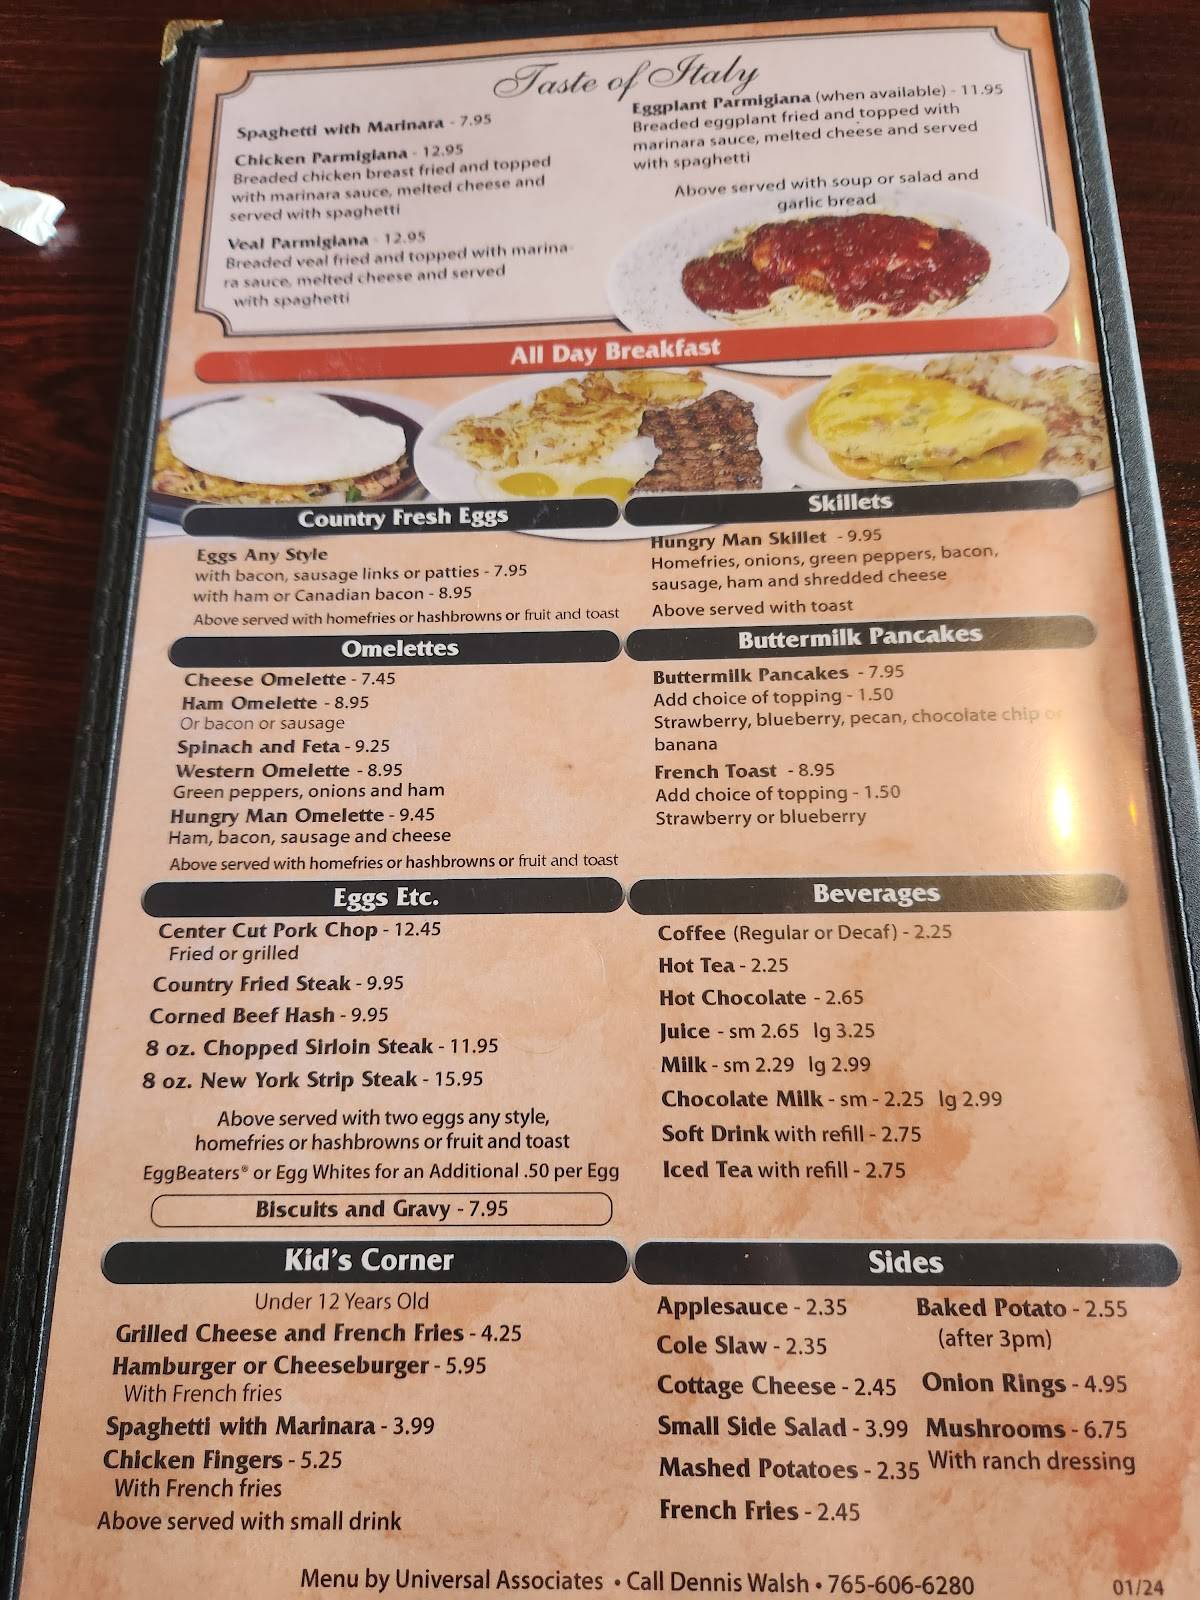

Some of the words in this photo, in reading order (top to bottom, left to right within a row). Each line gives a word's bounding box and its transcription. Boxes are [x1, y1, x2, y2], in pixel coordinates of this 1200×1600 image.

[493, 62, 598, 98] Taste
[608, 60, 651, 101] of
[648, 53, 759, 96] Italy
[632, 99, 706, 116] Eggplant
[713, 93, 811, 109] Parmigiana
[815, 89, 865, 103] (when
[869, 84, 946, 99] available)
[961, 83, 1003, 95] 11.95
[237, 124, 317, 142] Spaghetti
[324, 122, 360, 135] with
[367, 119, 444, 133] Marinara
[460, 113, 492, 126] 7.95
[633, 137, 705, 151] marinara
[764, 127, 821, 143] melted
[826, 126, 883, 139] cheese
[887, 122, 918, 135] and
[923, 120, 978, 134] served
[234, 153, 305, 166] Chicken
[312, 149, 408, 164] Parmigiana
[423, 143, 463, 157] 12.95
[674, 184, 727, 197] Above
[731, 178, 786, 193] served
[790, 175, 827, 189] with
[832, 176, 872, 188] soup
[877, 175, 894, 184] or
[899, 169, 942, 183] salad
[947, 168, 979, 181] and
[777, 196, 822, 212] garlic
[827, 192, 876, 207] bread
[227, 237, 264, 250] Veal
[271, 234, 369, 250] Parmigiana
[385, 231, 426, 245] 12.95
[510, 344, 543, 365] All
[552, 343, 597, 366] Day
[605, 337, 721, 360] Breakfast
[808, 492, 893, 512] Skillets
[297, 510, 386, 530] Country
[393, 507, 451, 525] Fresh
[459, 506, 509, 528] Eggs
[651, 531, 716, 551] Hungry
[722, 533, 762, 547] Man
[768, 530, 826, 545] Skillet
[847, 528, 882, 542] 9.95
[197, 548, 237, 565] Eggs
[244, 548, 279, 565] Any
[285, 547, 328, 564] Style
[651, 579, 722, 593] sausage,
[726, 575, 763, 588] ham
[767, 573, 799, 587] and
[804, 569, 883, 586] shredded
[888, 568, 947, 583] cheese
[193, 613, 239, 626] Above
[242, 612, 289, 626] served
[292, 612, 323, 625] with
[326, 611, 396, 624] homefries
[399, 614, 414, 623] or
[417, 610, 502, 623] hashbrowns
[505, 612, 520, 621] or
[524, 608, 551, 621] fruit
[555, 607, 581, 620] and
[586, 607, 619, 619] toast
[738, 627, 862, 649] Buttermilk
[869, 624, 983, 644] Pancakes
[341, 639, 459, 658] Omelettes
[184, 672, 253, 687] Cheese
[260, 672, 346, 686] Omelette
[361, 672, 395, 685] 7.45
[653, 668, 752, 685] Buttermilk
[758, 666, 849, 682] Pancakes
[868, 664, 904, 679] 7.95
[182, 696, 223, 710] Ham
[231, 696, 318, 710] Omelette
[334, 696, 369, 709] 8.95
[177, 739, 252, 758] Spinach
[259, 739, 295, 754] and
[302, 739, 340, 753] Feta
[355, 739, 390, 753] 9.25
[175, 764, 255, 778] Western
[262, 763, 350, 778] Omelette
[367, 763, 403, 777] 8.95
[655, 764, 719, 779] French
[724, 763, 777, 778] Toast
[798, 762, 835, 777] 8.95
[333, 887, 388, 912] Eggs
[396, 886, 439, 906] Etc.
[813, 883, 941, 907] Beverages
[158, 922, 226, 939] Center
[232, 922, 267, 938] Cut
[273, 922, 318, 938] Pork
[324, 921, 378, 941] Chop
[395, 921, 441, 936] 12.45
[658, 924, 726, 941] Coffee
[733, 924, 809, 944] (Regular
[814, 928, 833, 940] or
[838, 923, 897, 942] Decaf)
[913, 924, 952, 939] 2.25
[658, 957, 694, 973] Hot
[699, 957, 735, 973] Tea
[751, 957, 788, 972] 2.25
[149, 1007, 225, 1024] Corned
[232, 1006, 280, 1023] Beef
[285, 1006, 335, 1023] Hash
[351, 1007, 388, 1022] 9.95
[659, 1022, 710, 1044] Juice
[729, 1027, 755, 1039] sm
[761, 1023, 799, 1039] 2.65
[813, 1021, 831, 1043] lg
[836, 1022, 875, 1038] 3.25
[662, 1124, 704, 1142] Soft
[711, 1124, 770, 1142] Drink
[774, 1124, 816, 1142] with
[822, 1124, 864, 1142] refill
[881, 1126, 921, 1142] 2.75
[255, 1199, 338, 1218] Biscuits
[345, 1199, 385, 1217] and
[393, 1199, 451, 1222] Gravy
[469, 1200, 508, 1217] 7.95
[361, 1247, 454, 1271] Corner
[868, 1249, 944, 1273] Sides
[255, 1291, 312, 1310] Under
[319, 1292, 339, 1310] 12
[344, 1291, 391, 1310] Years
[397, 1291, 429, 1310] Old
[656, 1295, 788, 1320] Applesauce
[806, 1298, 847, 1316] 2.35
[916, 1297, 987, 1317] Baked
[994, 1297, 1067, 1317] Potato
[1084, 1299, 1127, 1318] 2.55
[116, 1323, 188, 1343] Grilled
[195, 1323, 277, 1342] Cheese
[284, 1323, 326, 1342] and
[333, 1322, 405, 1342] French
[414, 1322, 464, 1342] Fries
[480, 1324, 521, 1342] 4.25
[938, 1327, 994, 1349] (after
[999, 1329, 1051, 1352] 3pm)
[922, 1371, 994, 1392] Onion
[1002, 1372, 1067, 1398] Rings
[1084, 1374, 1127, 1393] 4.95
[926, 1417, 1066, 1438] Mushrooms
[1083, 1420, 1127, 1439] 6.75
[96, 1510, 162, 1530] Above
[167, 1510, 234, 1530] served
[240, 1510, 284, 1530] with
[290, 1510, 343, 1530] small
[349, 1510, 401, 1531] drink
[300, 1568, 359, 1588] Menu
[365, 1567, 390, 1593] by
[396, 1568, 490, 1589] Universal
[495, 1569, 603, 1590] Associates
[626, 1570, 664, 1591] Call
[670, 1571, 742, 1592] Dennis
[747, 1572, 809, 1593] Walsh
[828, 1574, 974, 1595] 765-606-6280
[1113, 1579, 1164, 1596] 01/24
